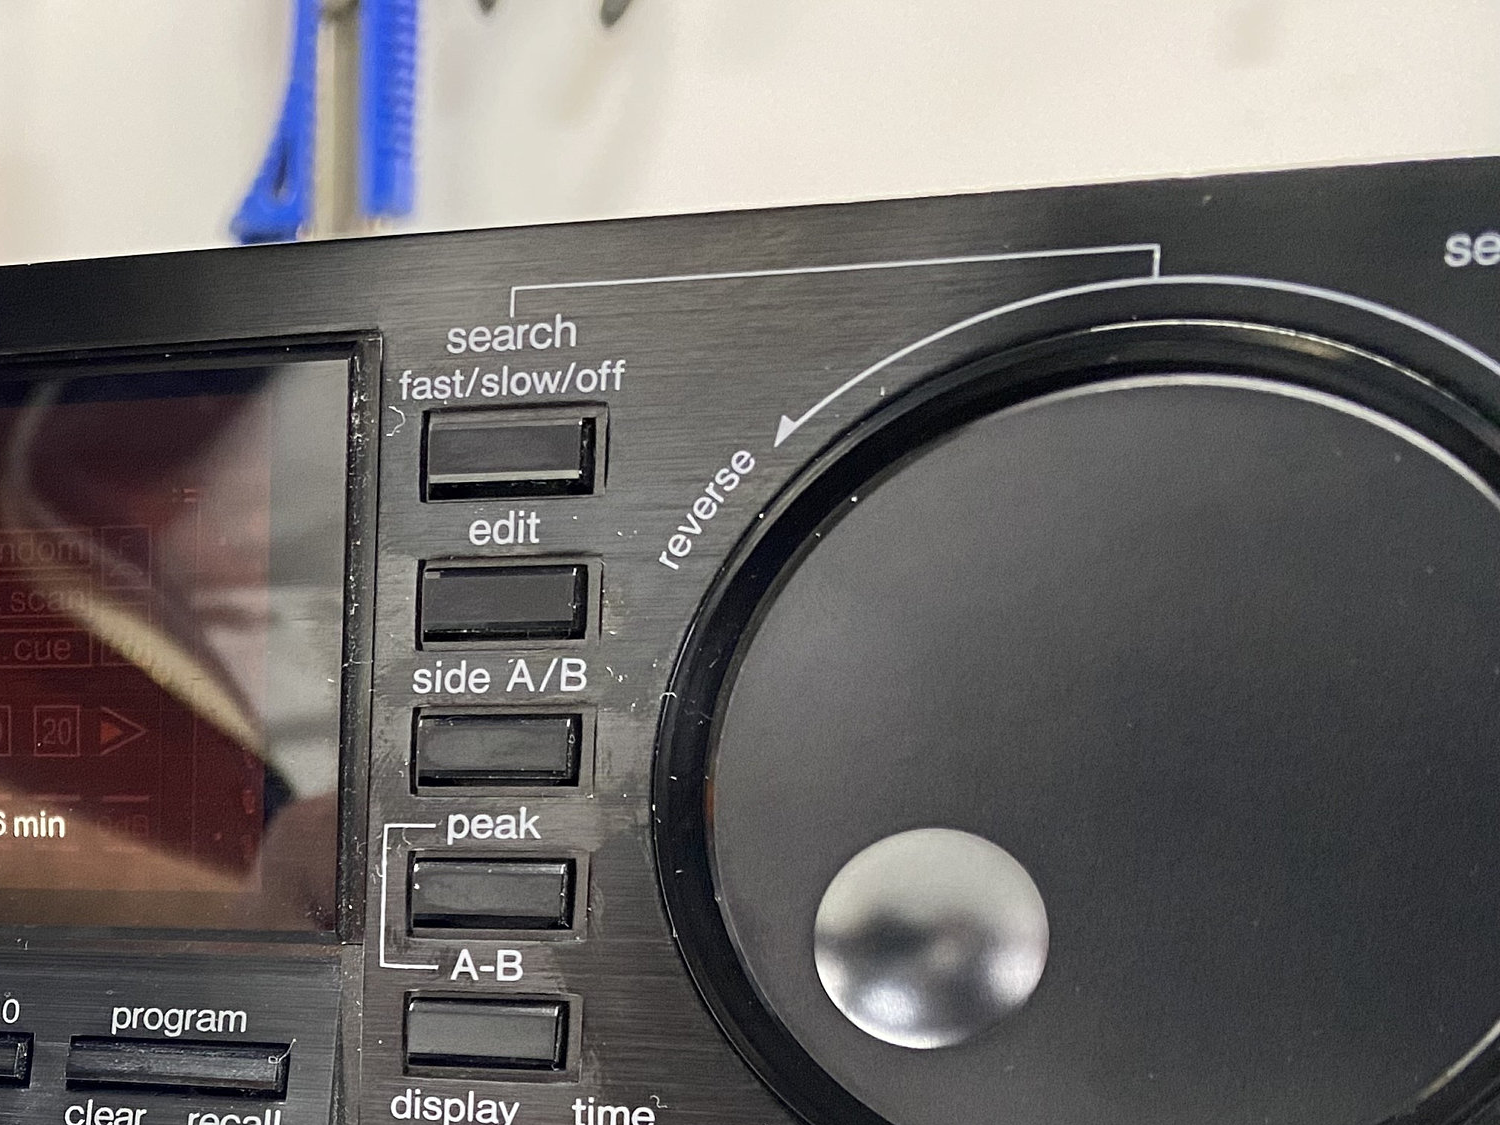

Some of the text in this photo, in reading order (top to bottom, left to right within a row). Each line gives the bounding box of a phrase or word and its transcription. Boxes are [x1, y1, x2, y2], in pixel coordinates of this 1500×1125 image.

[1444, 231, 1500, 267] se
[446, 314, 577, 353] search
[399, 360, 626, 400] fast/slow/off
[658, 448, 756, 571] reverse
[469, 510, 541, 545] edit
[14, 640, 71, 661] cue
[412, 657, 588, 694] side A/B
[42, 717, 71, 745] 20
[14, 811, 67, 838] min
[446, 807, 542, 845] peak
[450, 949, 524, 982] A-B
[111, 1004, 247, 1037] program
